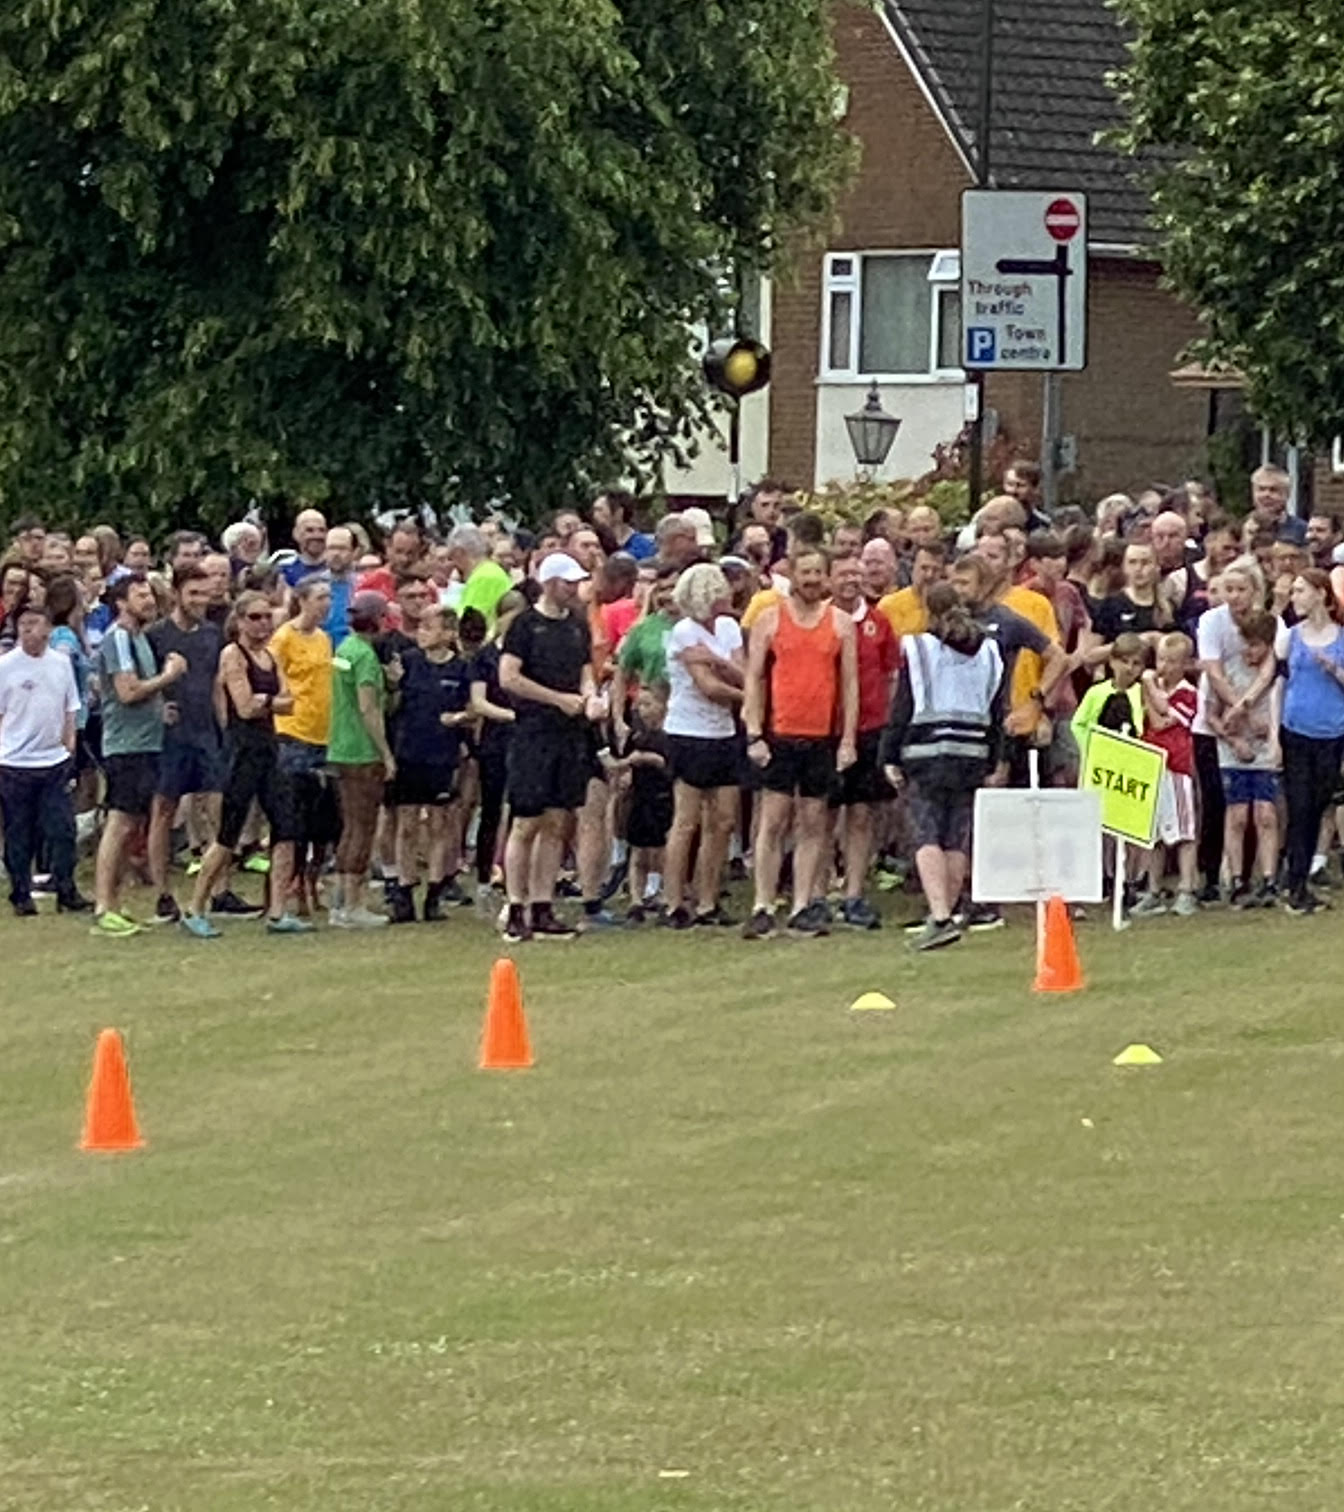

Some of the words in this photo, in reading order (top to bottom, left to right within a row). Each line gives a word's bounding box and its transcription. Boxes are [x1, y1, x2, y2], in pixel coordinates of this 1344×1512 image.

[968, 280, 1033, 298] Through
[976, 300, 1024, 315] traffic
[1006, 324, 1046, 340] Town
[973, 330, 992, 359] P
[1092, 767, 1150, 802] START
